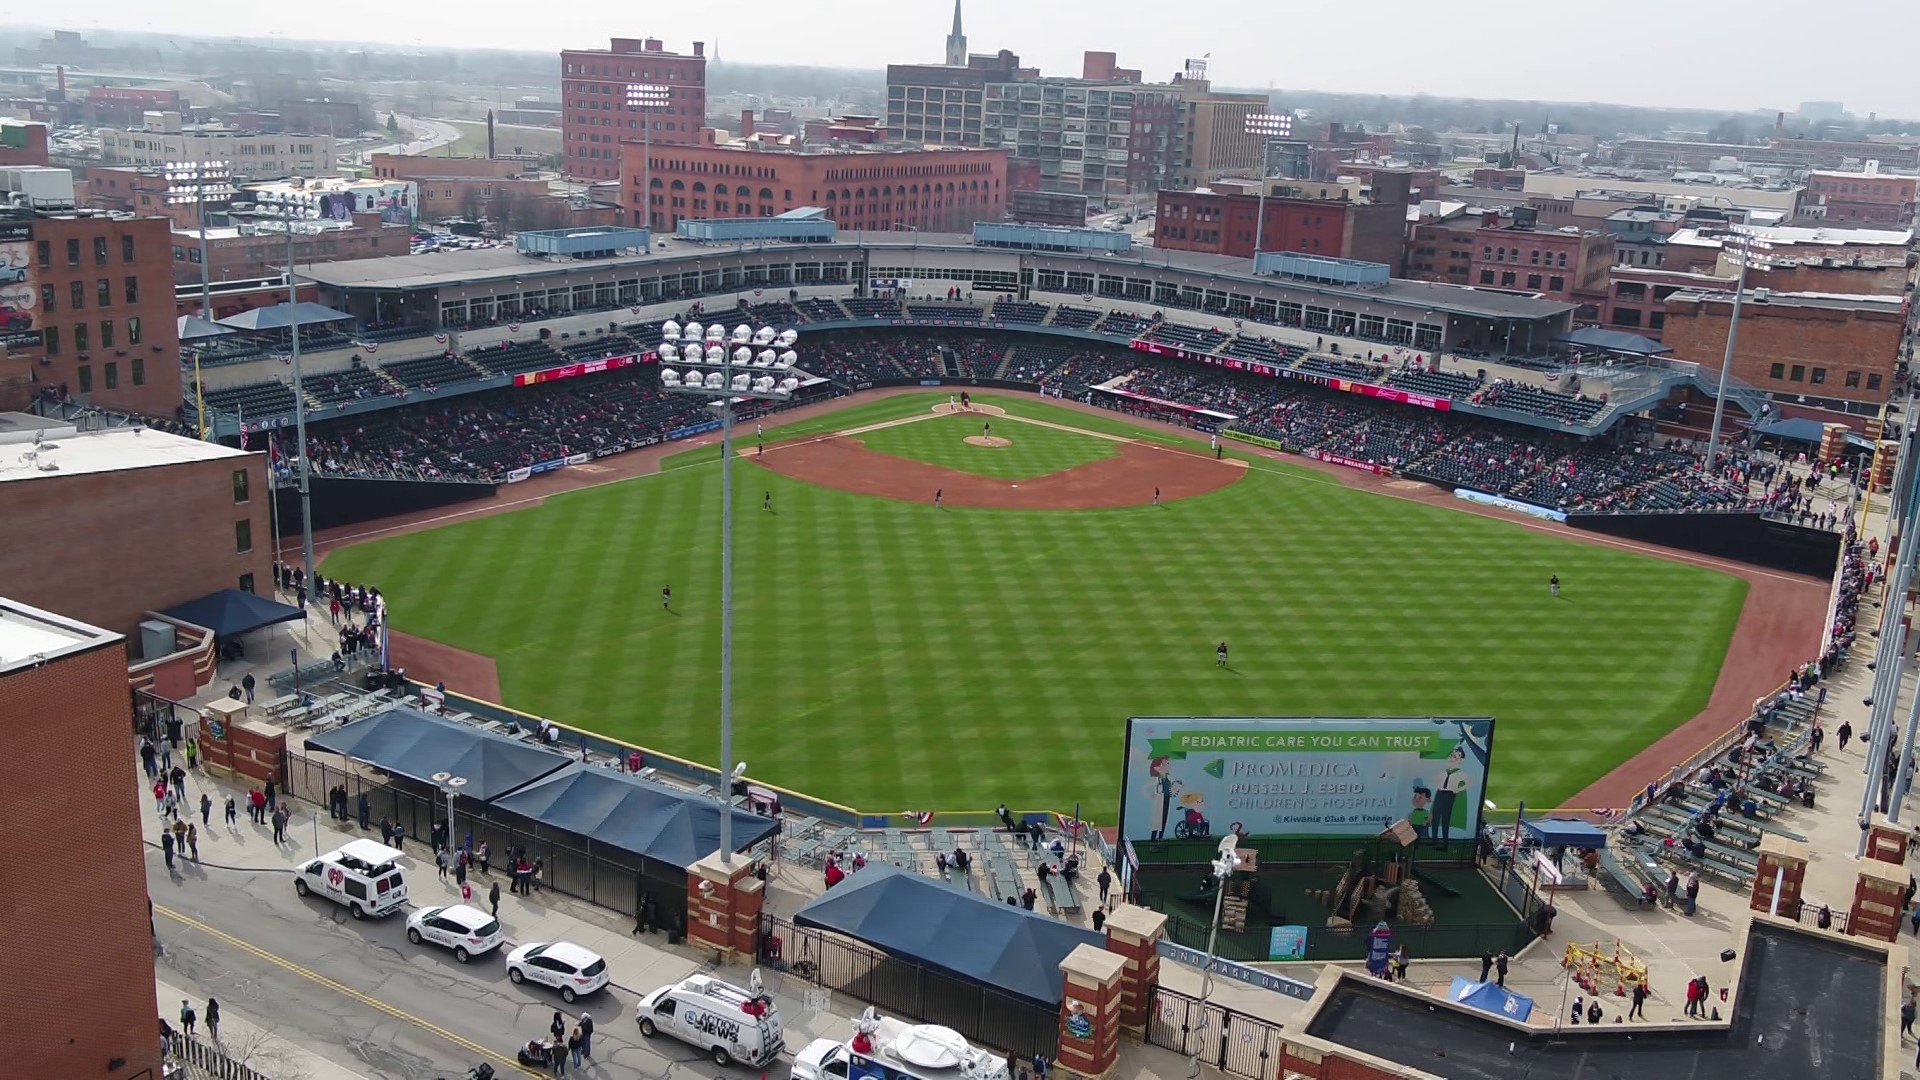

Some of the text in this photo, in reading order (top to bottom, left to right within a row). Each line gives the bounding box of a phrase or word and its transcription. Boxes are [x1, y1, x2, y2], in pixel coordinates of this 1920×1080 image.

[1181, 736, 1430, 747] PEDIATRIC CARE YOU CAN TRUST
[1229, 783, 1296, 794] RUSSELL
[1228, 798, 1395, 809] CHILDREN'S HOSPITAL
[1283, 814, 1393, 823] Kiwanis Club of Toledo
[1169, 948, 1200, 965] 2ND
[700, 1011, 740, 1034] ACTION
[702, 1020, 739, 1043] NEWS
